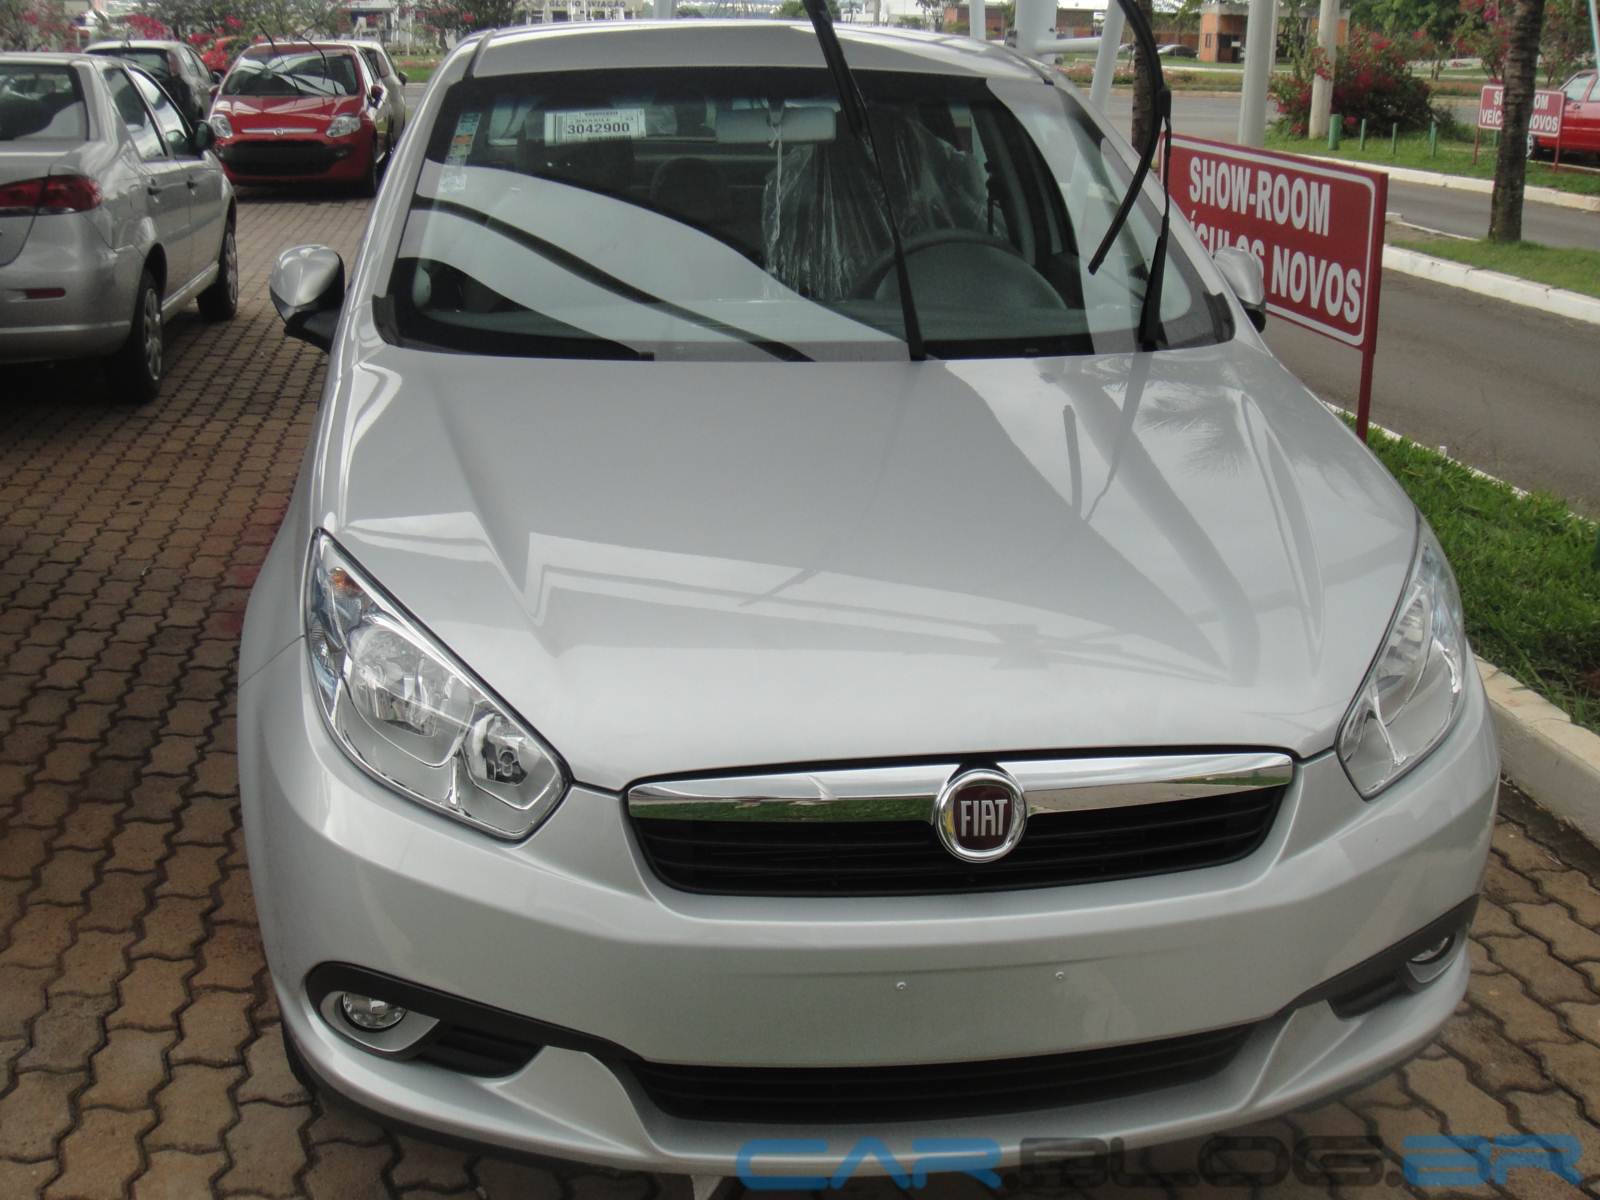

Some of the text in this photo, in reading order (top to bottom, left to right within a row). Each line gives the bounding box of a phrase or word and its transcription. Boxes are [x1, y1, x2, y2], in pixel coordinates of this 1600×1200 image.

[567, 121, 630, 135] 3042900
[1482, 106, 1503, 126] VEÍC
[1189, 157, 1331, 237] SHOW-ROOM
[1271, 245, 1362, 324] NOVOS
[960, 799, 1008, 837] FIAT
